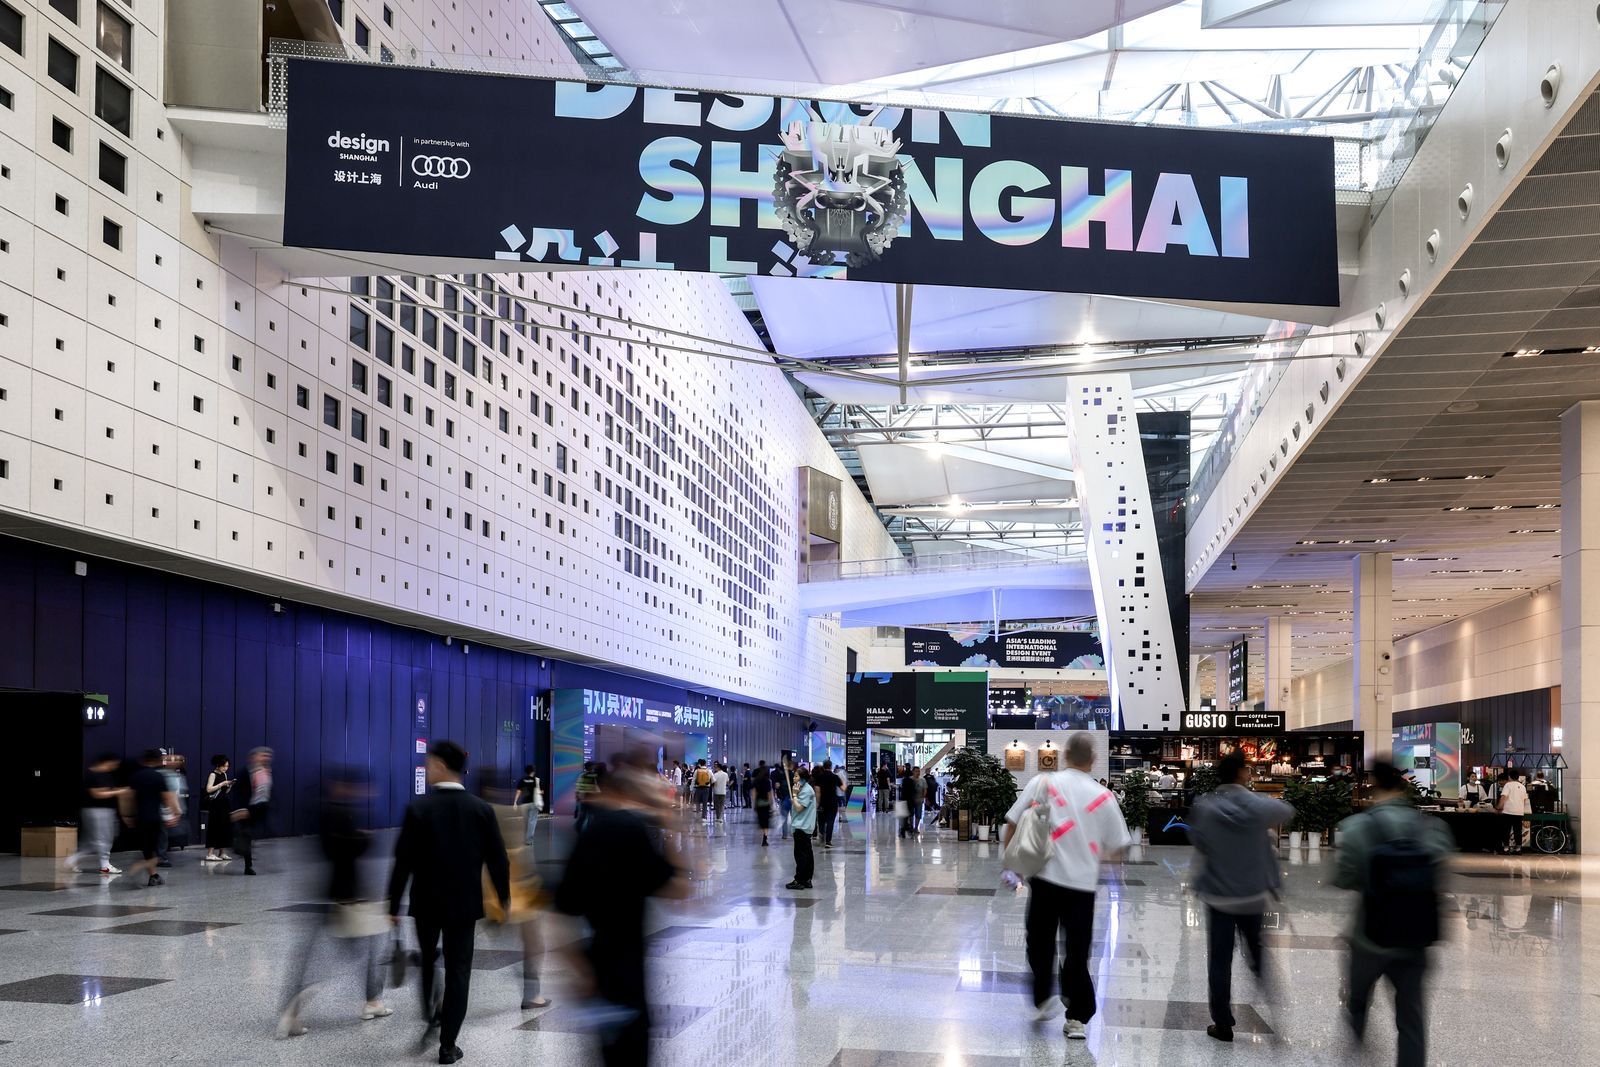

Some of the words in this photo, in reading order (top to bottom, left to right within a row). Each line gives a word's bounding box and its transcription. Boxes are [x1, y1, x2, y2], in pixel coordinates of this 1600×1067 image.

[328, 131, 390, 154] design
[420, 138, 456, 148] partnership
[339, 153, 378, 162] SHANGHAI
[333, 170, 382, 185] 设计上海
[413, 180, 438, 190] Audi
[635, 136, 1249, 259] SHNGHAI
[1006, 637, 1028, 645] ASIA'S
[1185, 714, 1227, 728] GUSTO
